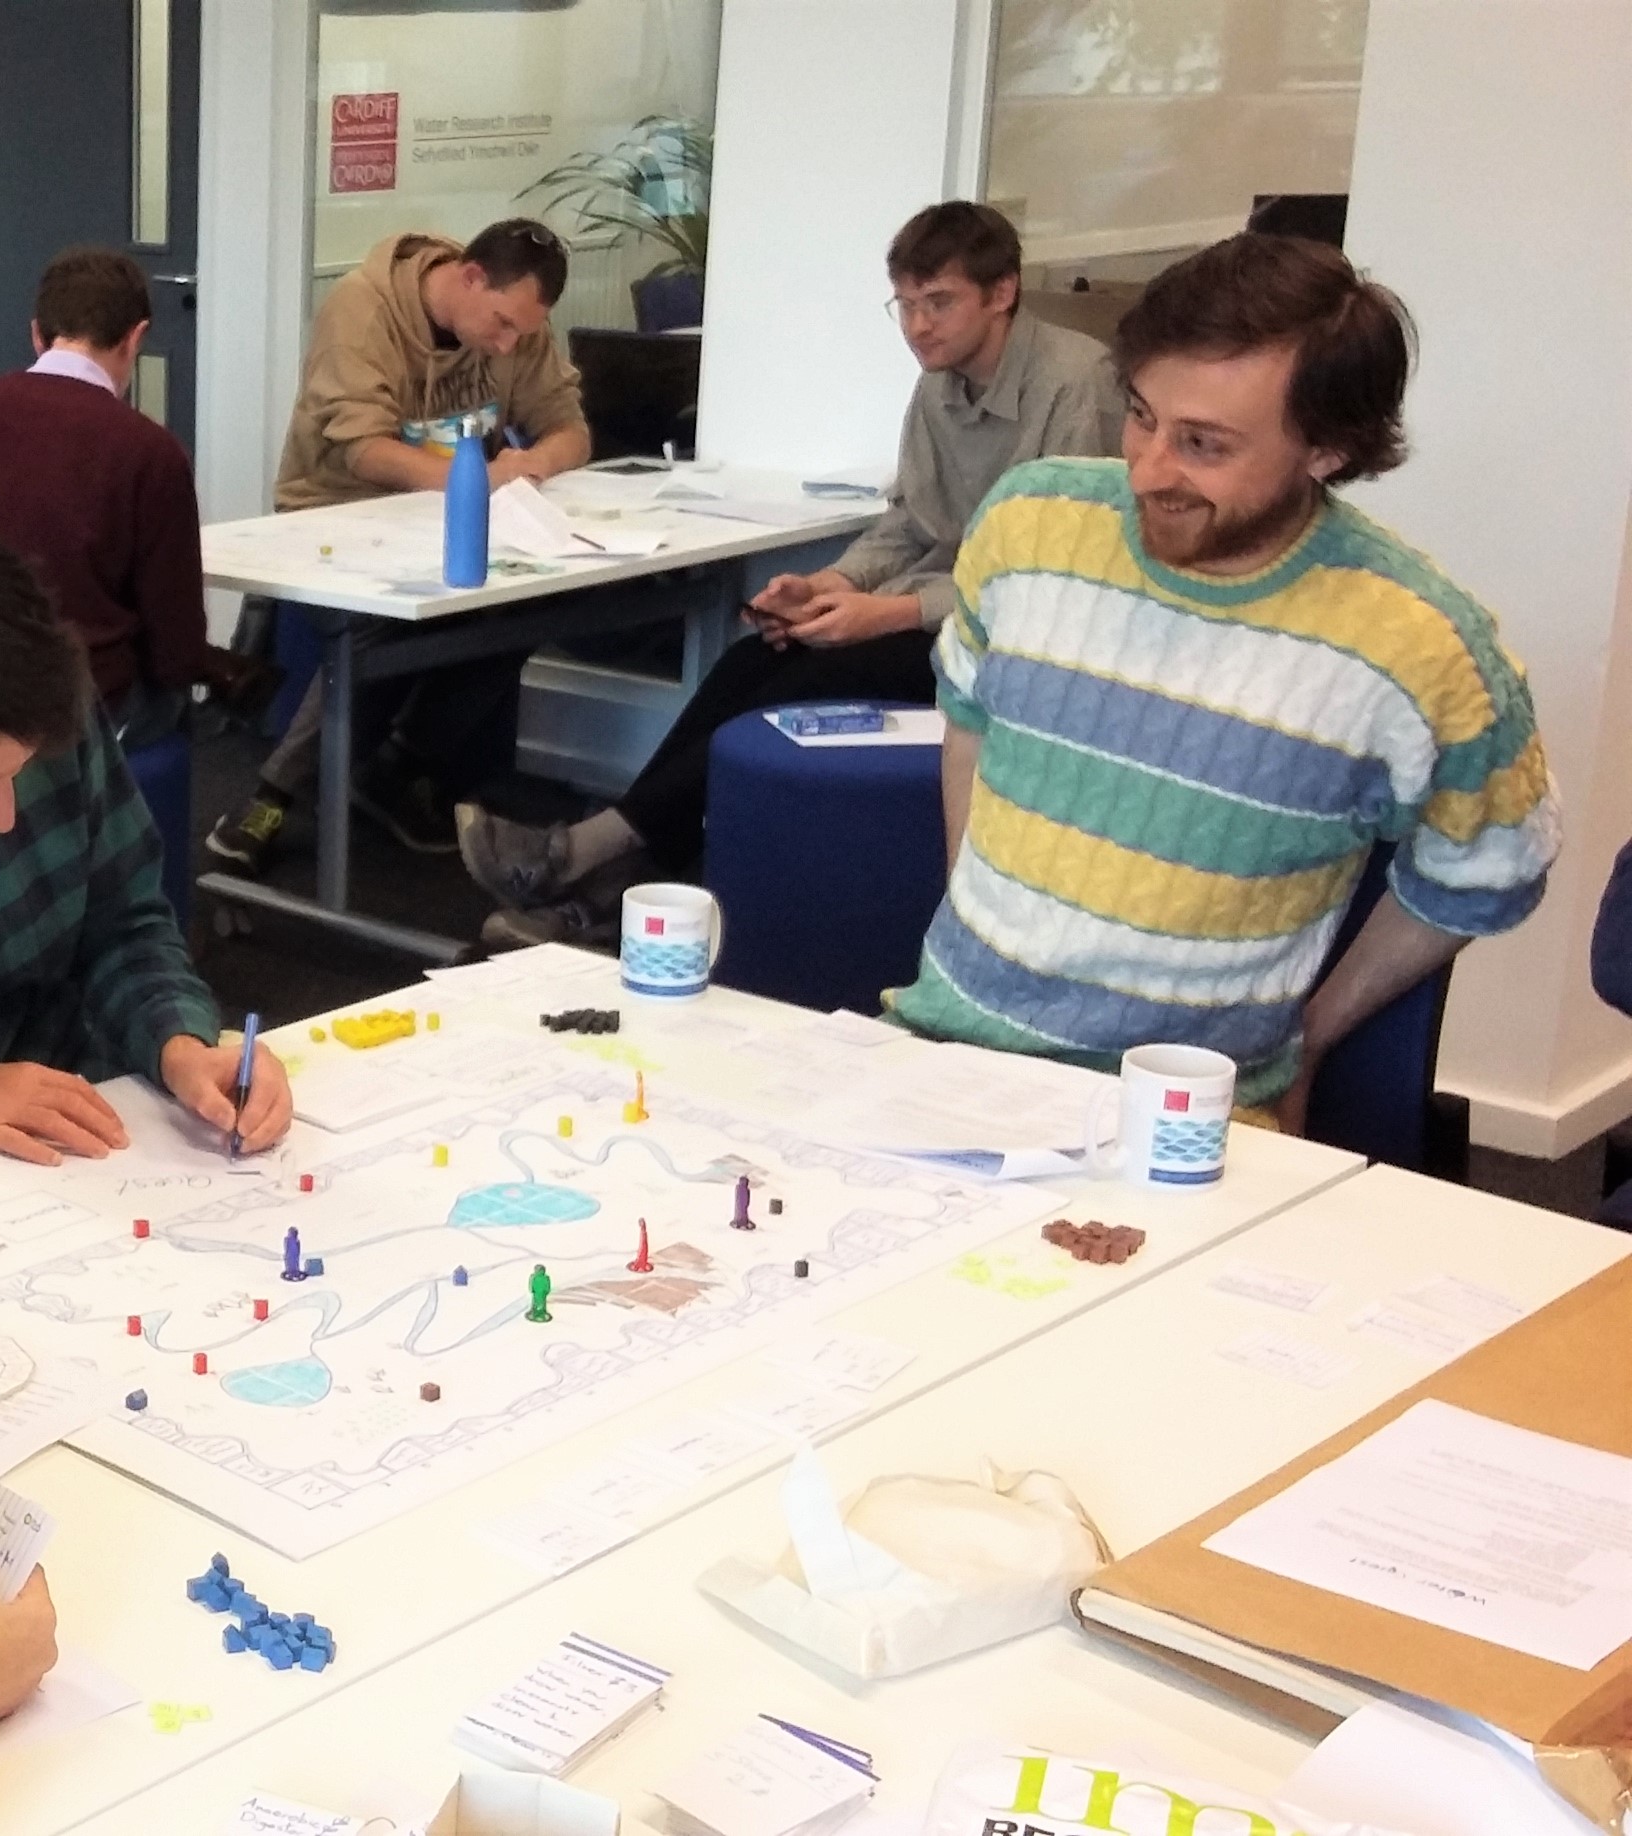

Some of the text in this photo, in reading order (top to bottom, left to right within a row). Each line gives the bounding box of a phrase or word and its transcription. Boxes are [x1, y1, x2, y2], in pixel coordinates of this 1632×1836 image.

[334, 97, 396, 123] CARDIFF
[451, 115, 504, 132] Research
[241, 1797, 320, 1829] Anaerobic
